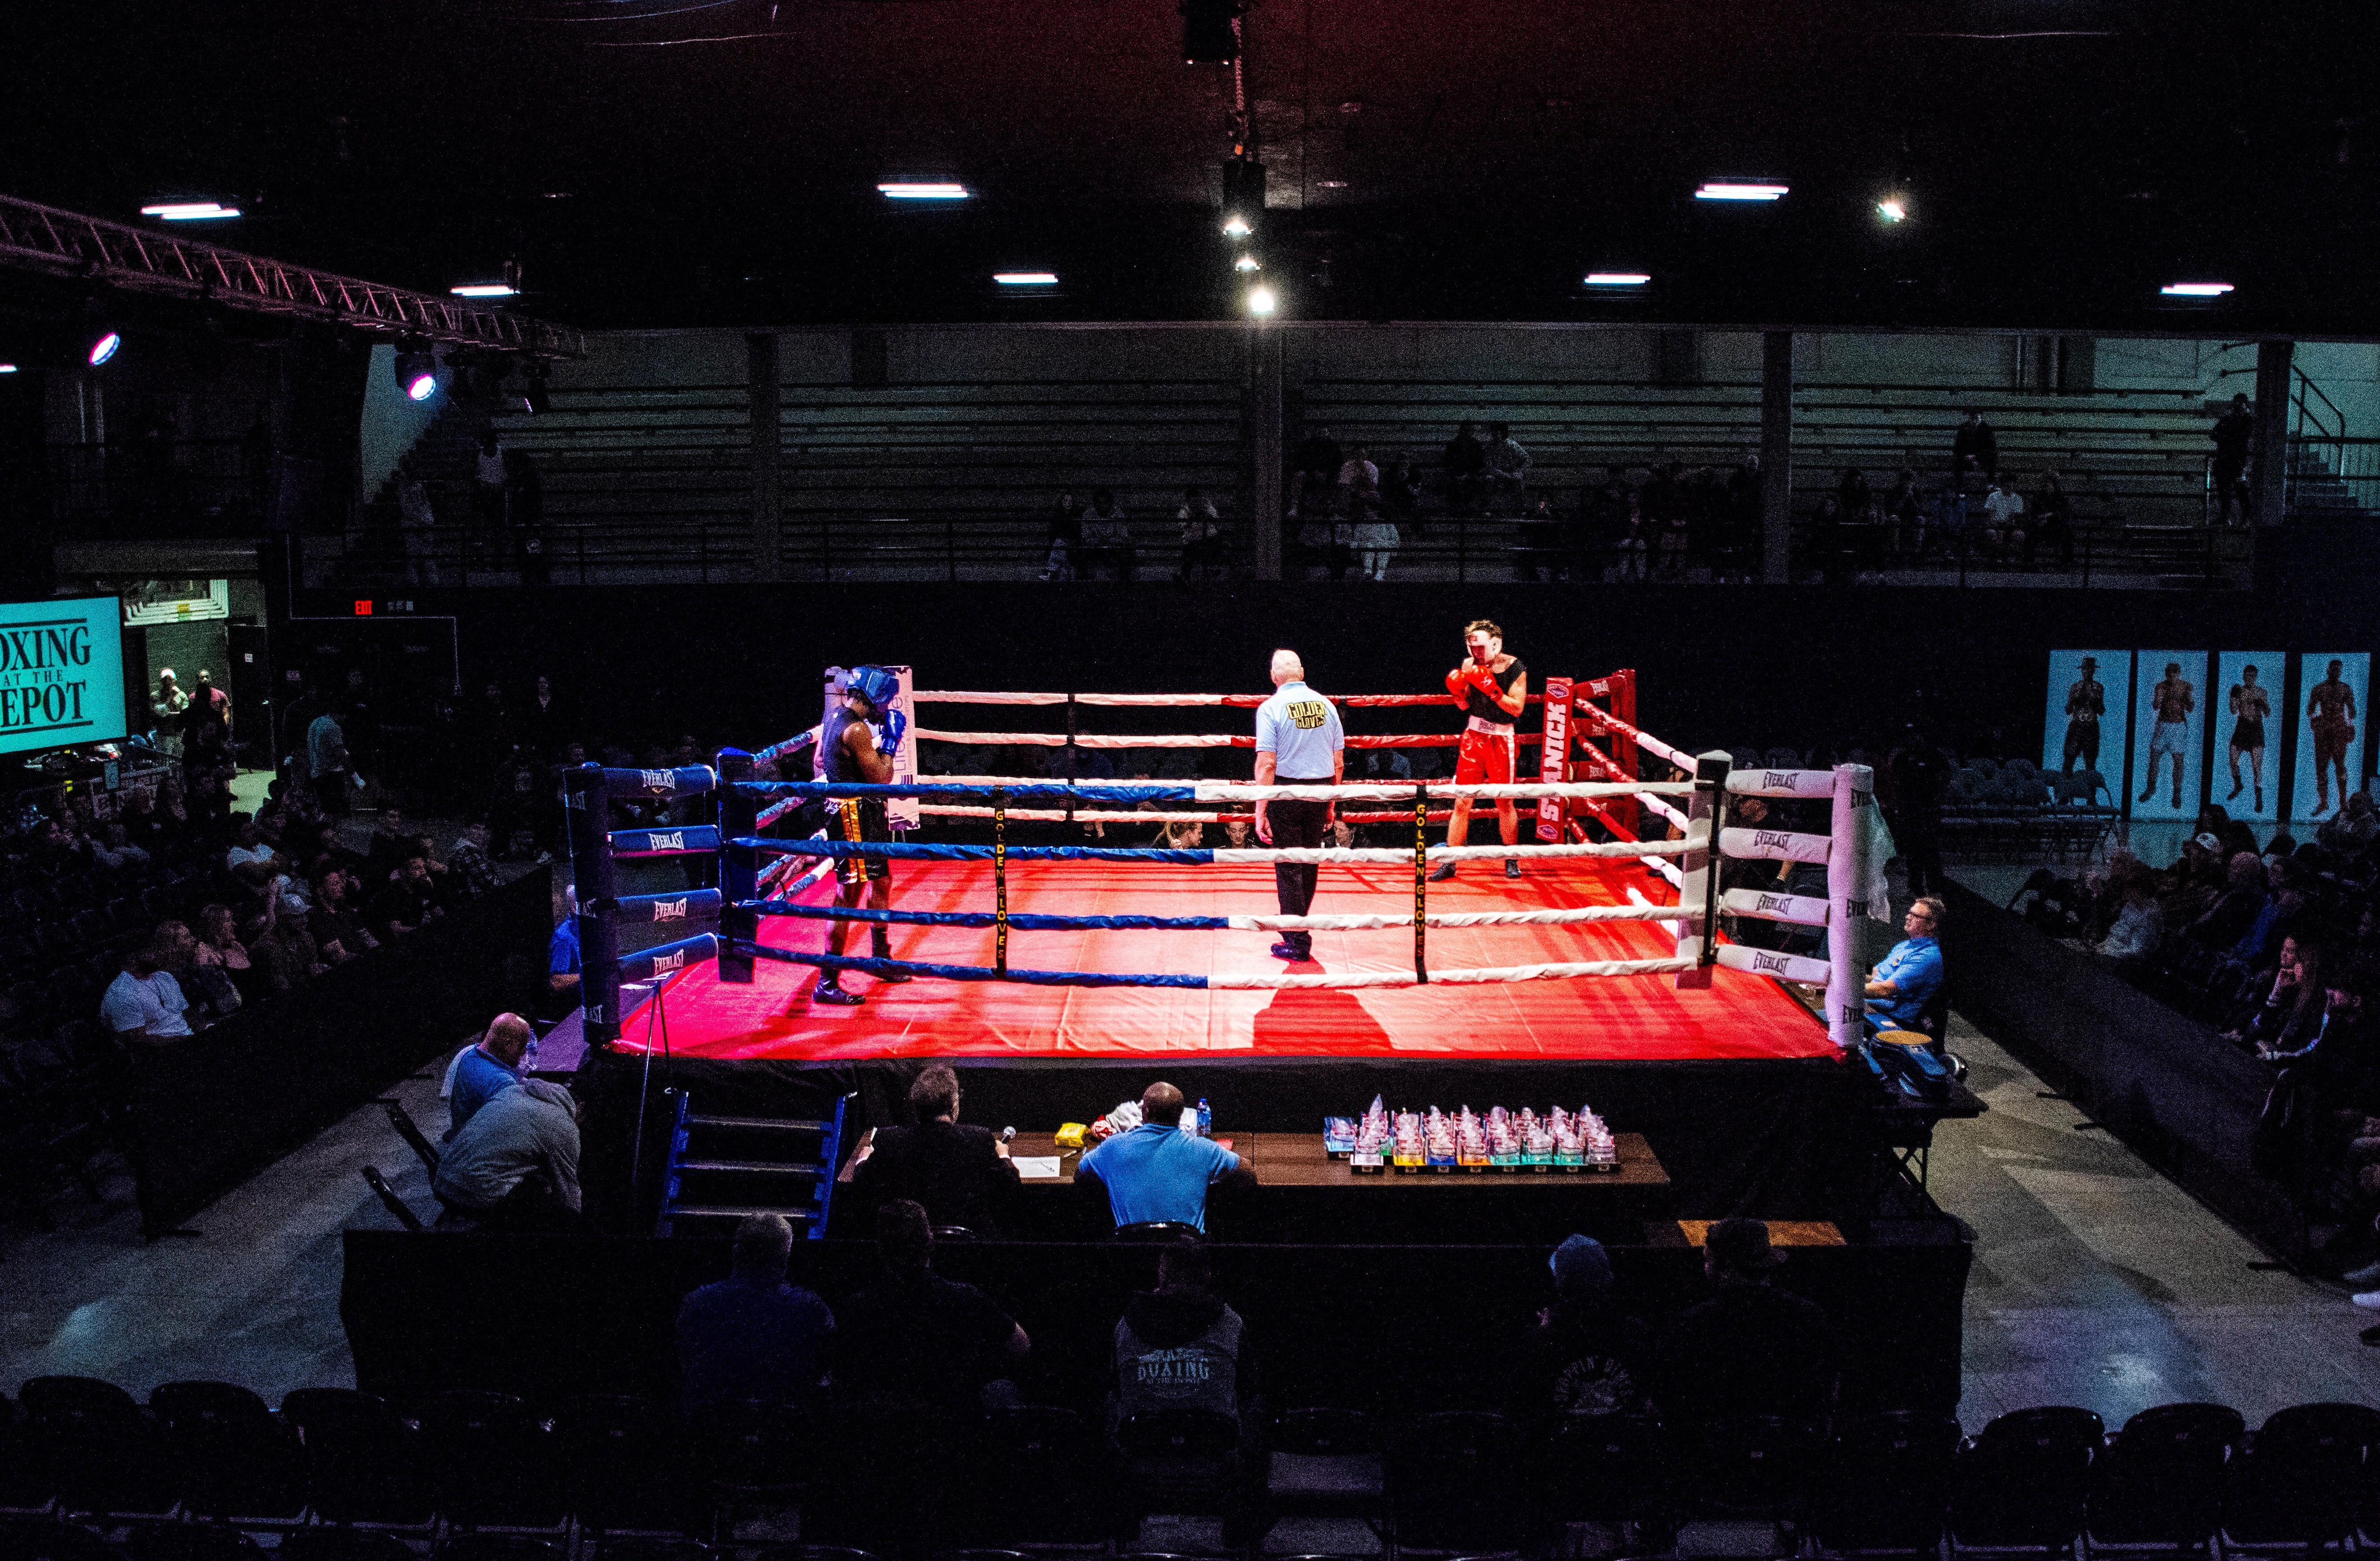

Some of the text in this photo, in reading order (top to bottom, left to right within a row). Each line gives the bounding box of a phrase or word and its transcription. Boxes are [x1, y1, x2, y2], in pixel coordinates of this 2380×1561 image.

[355, 600, 372, 615] EXIT
[3, 669, 63, 687] AT THE
[1286, 701, 1327, 719] GOLDEN
[1296, 714, 1326, 728] GLOVES
[641, 769, 676, 790] EVERLAST
[1762, 771, 1799, 791] EVERLAST
[648, 831, 684, 851] EVERLAST
[1754, 830, 1793, 851] EVERLAST
[996, 811, 1007, 959] GOLDEN GLOVES
[1416, 804, 1426, 957] GOLDEN GLOVES
[654, 897, 687, 921] EVERLAST
[1756, 894, 1793, 915] EVERLAST
[653, 948, 684, 976] EVERLAST
[1753, 952, 1791, 976] EVERLAST
